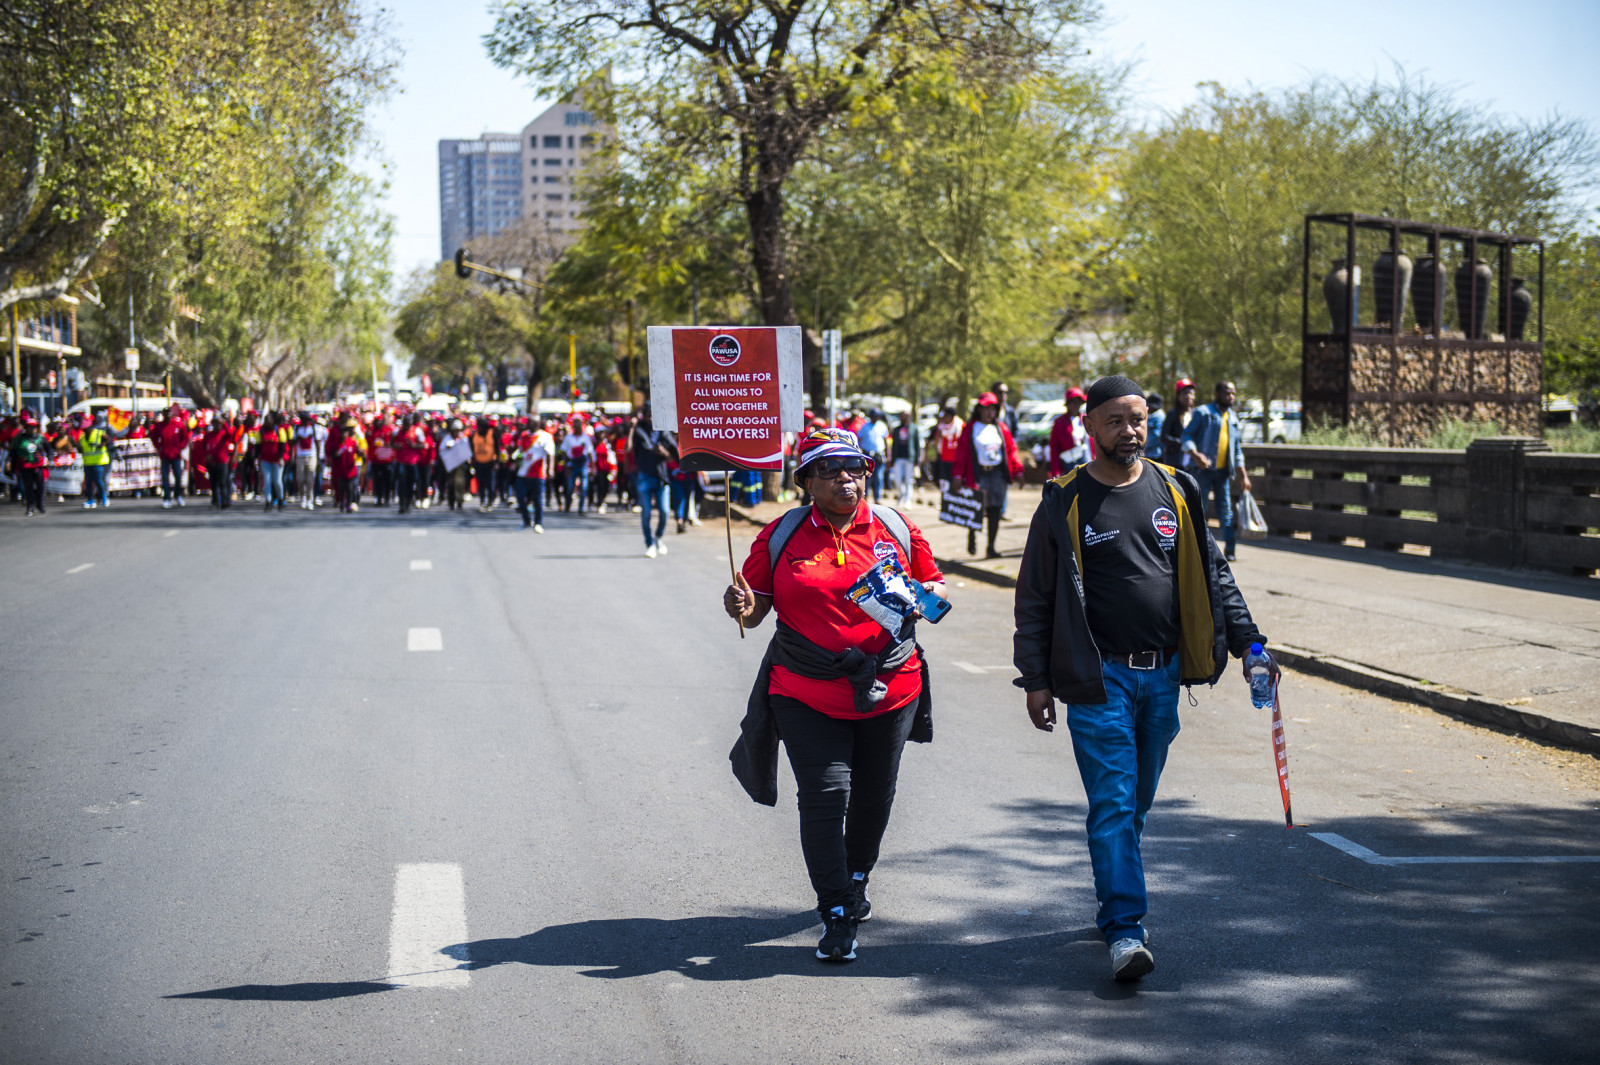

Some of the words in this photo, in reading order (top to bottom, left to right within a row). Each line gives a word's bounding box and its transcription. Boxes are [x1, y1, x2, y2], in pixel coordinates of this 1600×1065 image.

[684, 373, 691, 382] IT
[693, 373, 702, 382] IS
[704, 374, 727, 382] HIGH
[729, 374, 751, 382] TIME
[752, 373, 772, 381] FOR
[694, 388, 710, 397] ALL
[712, 388, 748, 397] UNIONS
[750, 388, 763, 396] TO
[690, 402, 720, 411] COME
[721, 402, 768, 411] TOGETHER
[683, 416, 723, 425] AGAINST
[725, 416, 778, 425] ARROGANT
[693, 428, 770, 439] EMPLOYERS!
[943, 492, 982, 511] Electricity
[948, 503, 975, 520] Pricing
[1085, 529, 1120, 543] METROPOLITAN
